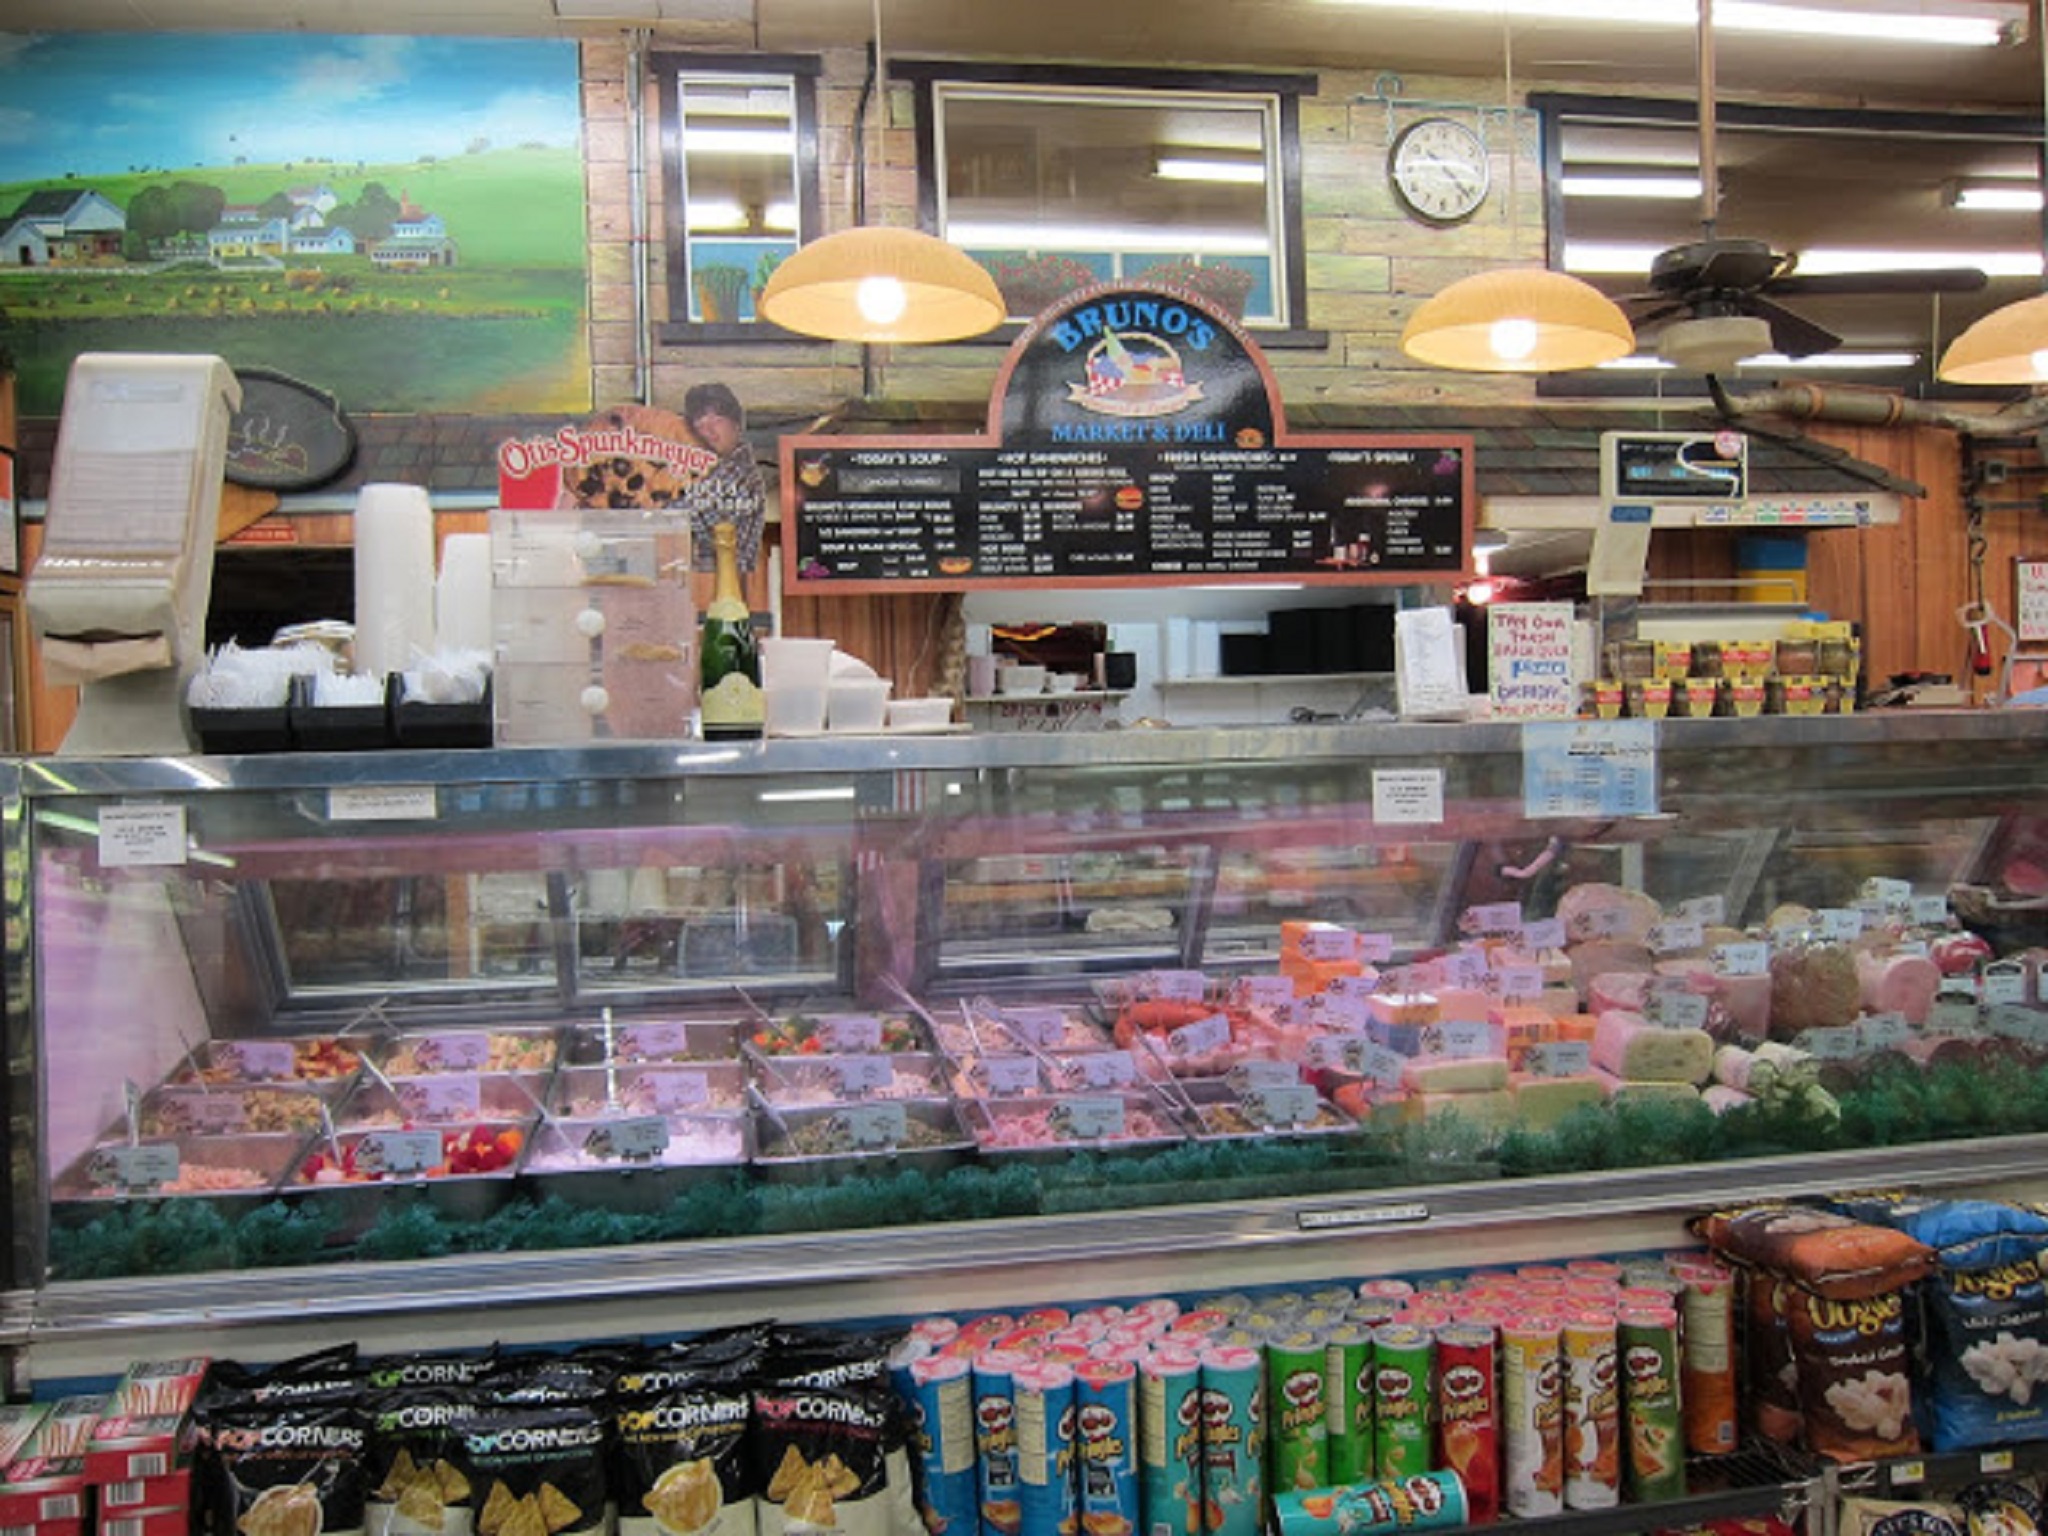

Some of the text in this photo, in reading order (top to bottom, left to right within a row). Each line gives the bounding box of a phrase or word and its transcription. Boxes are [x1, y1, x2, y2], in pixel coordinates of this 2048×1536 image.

[1052, 301, 1216, 353] BRUNO'S
[500, 426, 717, 479] Otis Spunkmeyer
[1051, 422, 1226, 443] MARKET & DELI
